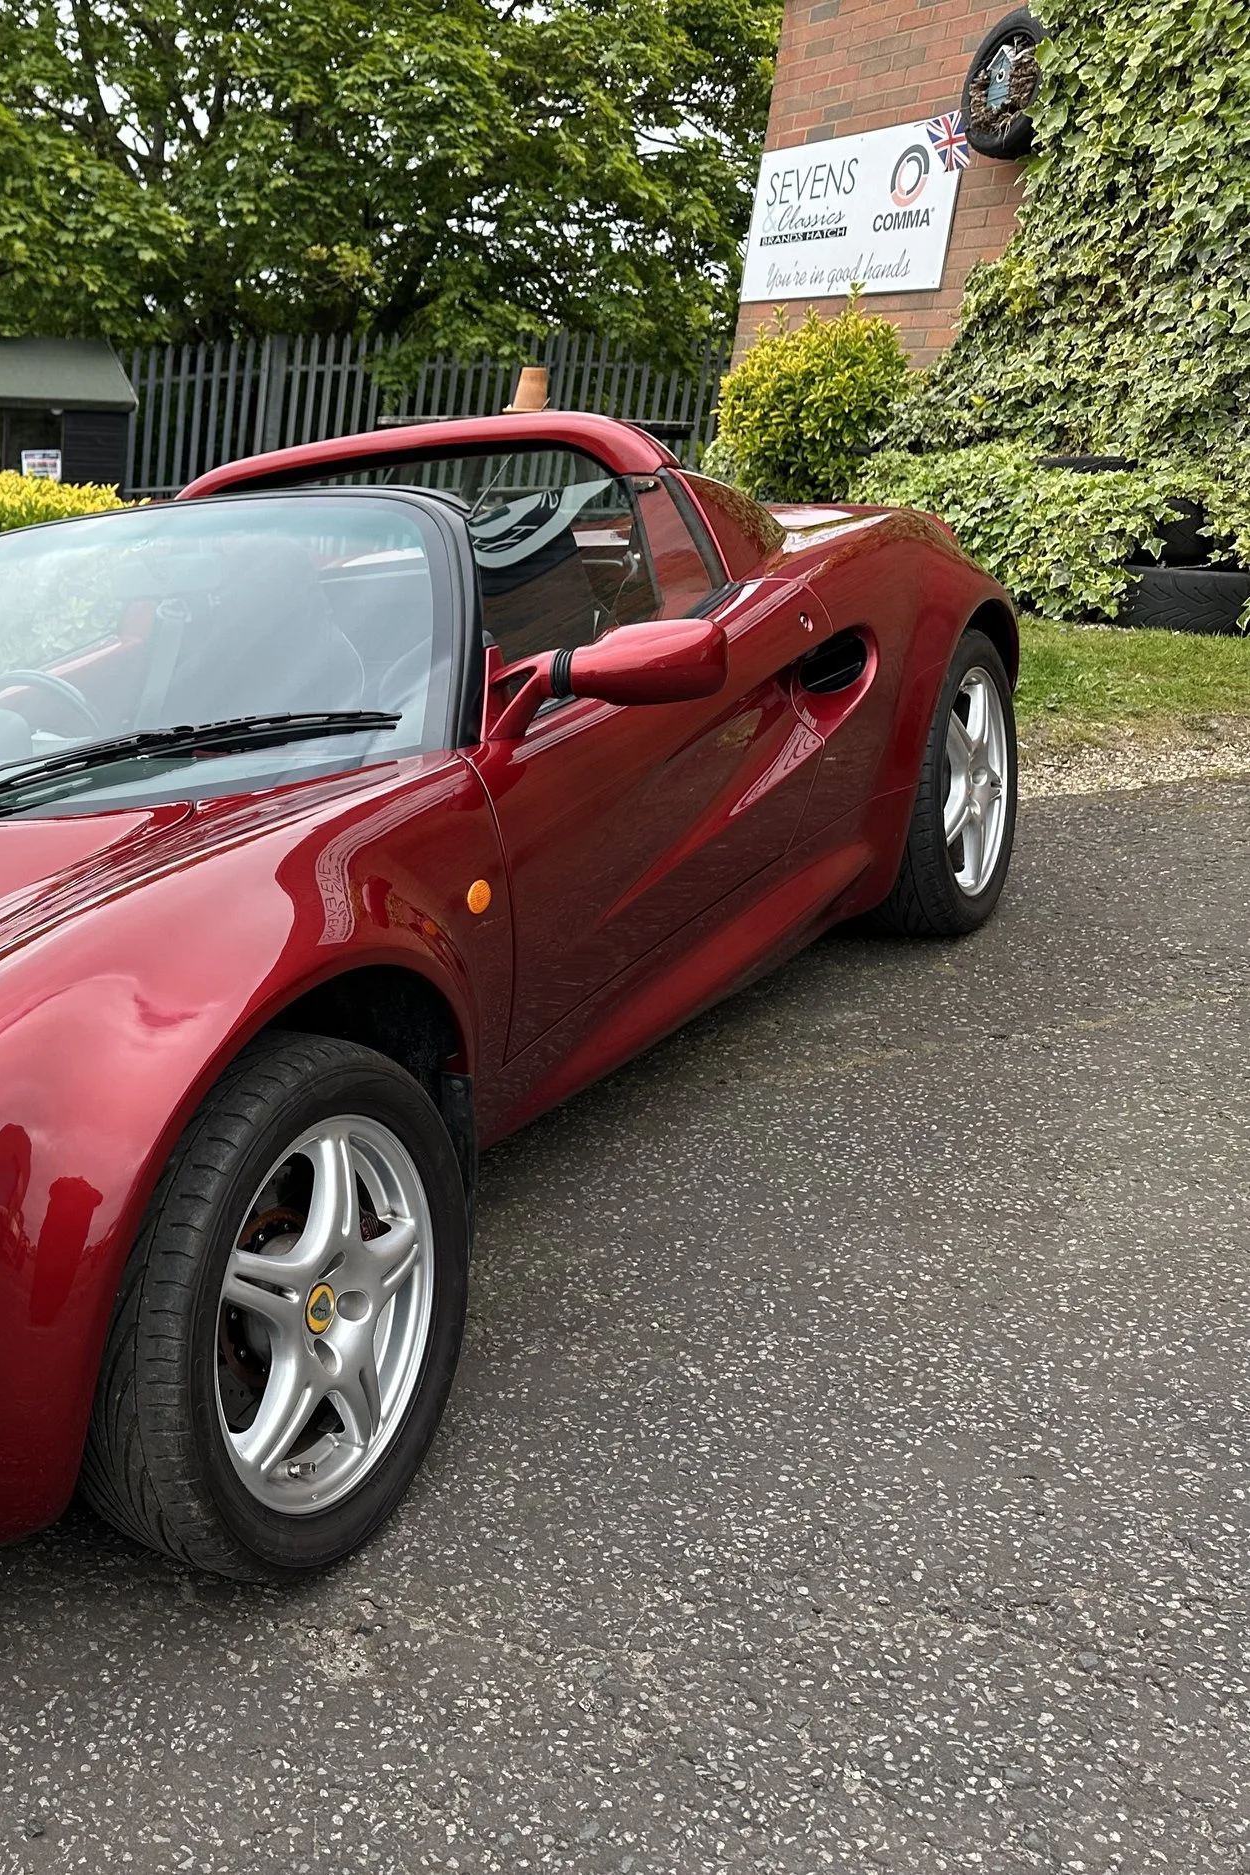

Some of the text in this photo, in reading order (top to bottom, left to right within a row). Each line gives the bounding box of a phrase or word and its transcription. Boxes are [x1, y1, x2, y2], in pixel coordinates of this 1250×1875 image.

[766, 157, 859, 207] SEVENS
[762, 227, 846, 246] BRANDS HATCH
[778, 205, 845, 232] Classics
[766, 248, 911, 295] You're in good hands
